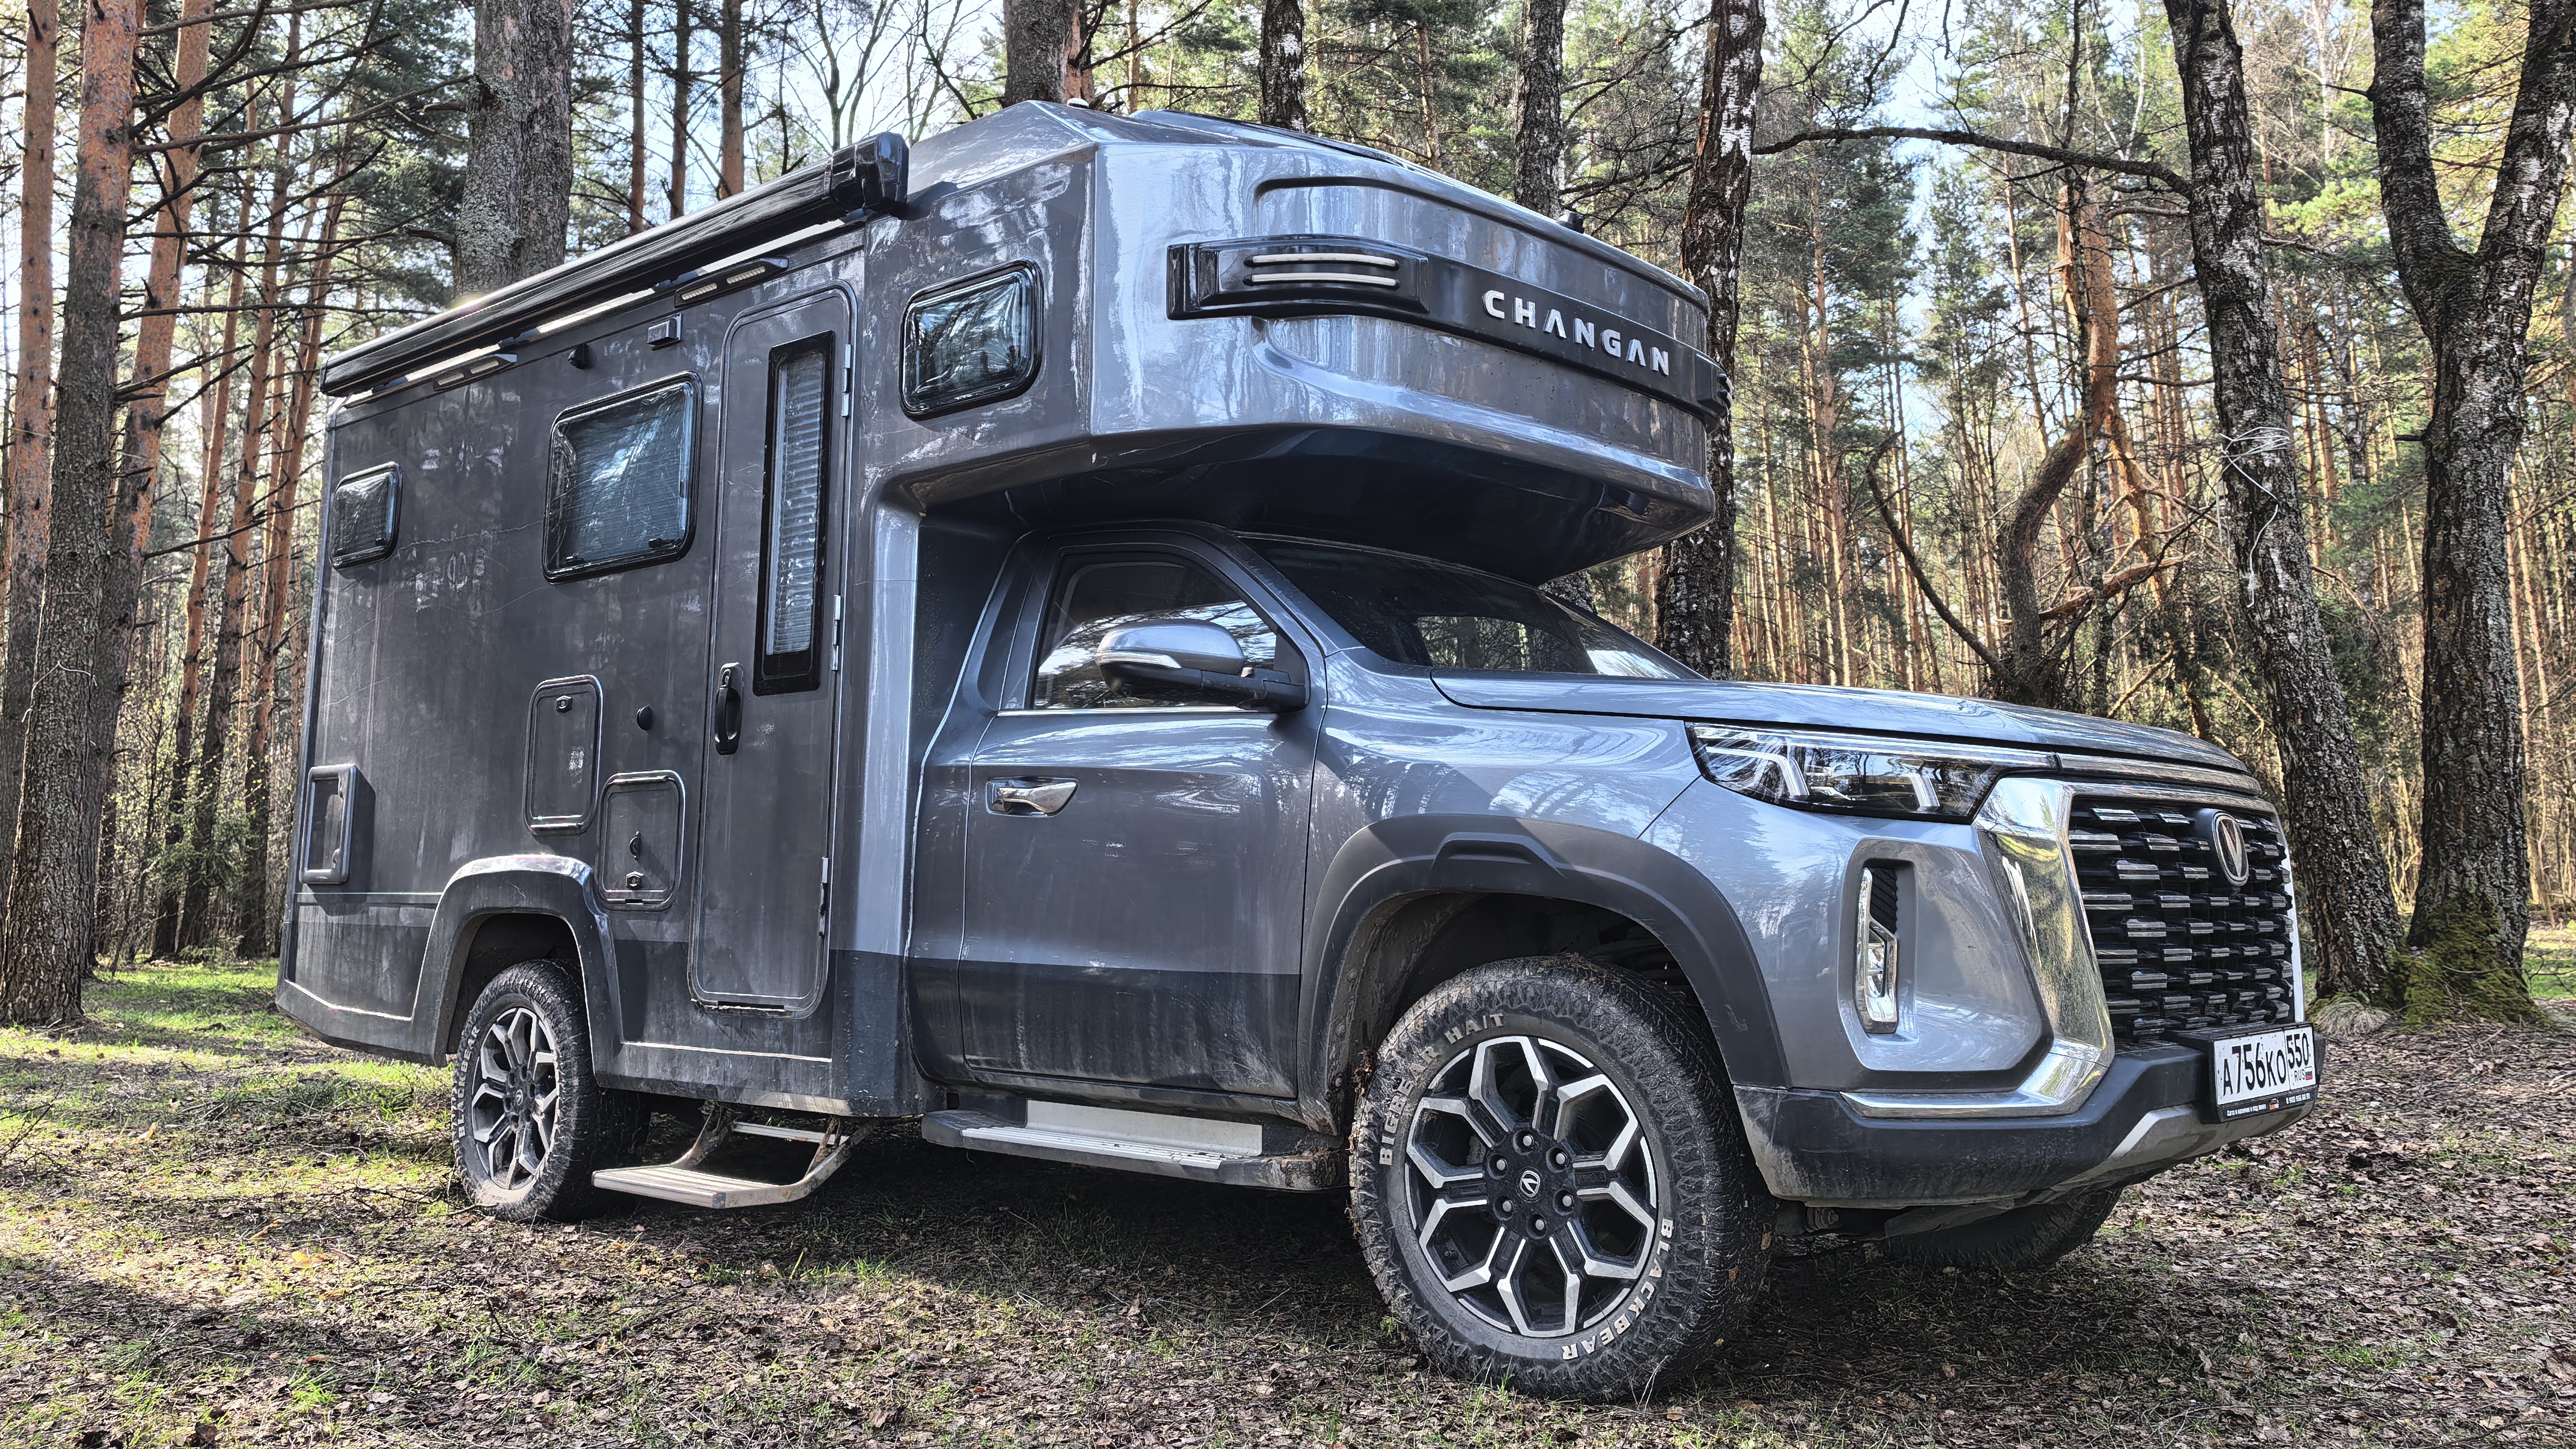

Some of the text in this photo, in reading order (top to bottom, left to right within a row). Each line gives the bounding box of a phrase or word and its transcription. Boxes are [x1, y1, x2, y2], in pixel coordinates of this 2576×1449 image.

[1482, 290, 1669, 376] CHANGAN
[458, 1026, 481, 1138] BLACKBEAR
[2286, 1033, 2311, 1069] 550
[2294, 1068, 2305, 1082] RUS
[1561, 1218, 1674, 1360] BLACKBEAR
